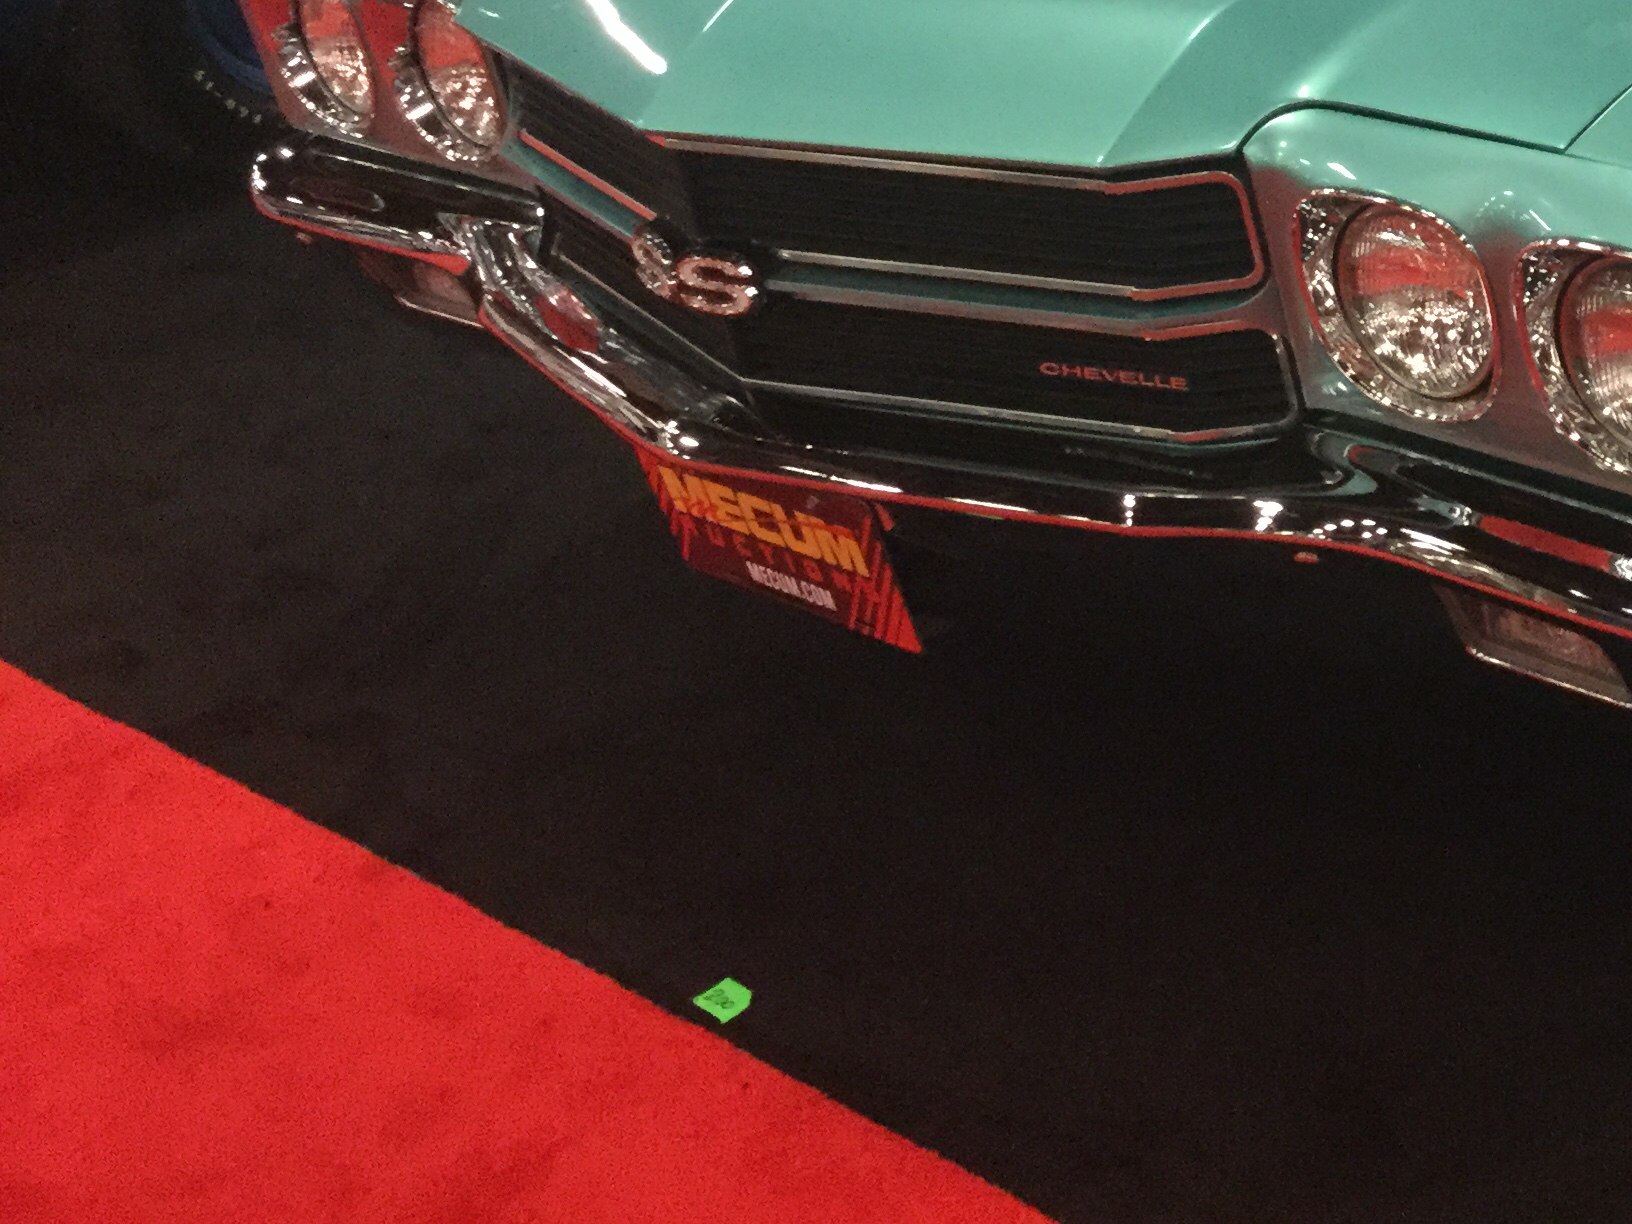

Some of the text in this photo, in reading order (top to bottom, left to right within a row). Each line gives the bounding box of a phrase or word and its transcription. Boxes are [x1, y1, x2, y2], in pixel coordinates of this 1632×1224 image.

[631, 232, 758, 317] SS
[1038, 360, 1191, 392] CHEVELLE
[658, 464, 871, 578] MECUM
[744, 559, 838, 612] MECUM.COM
